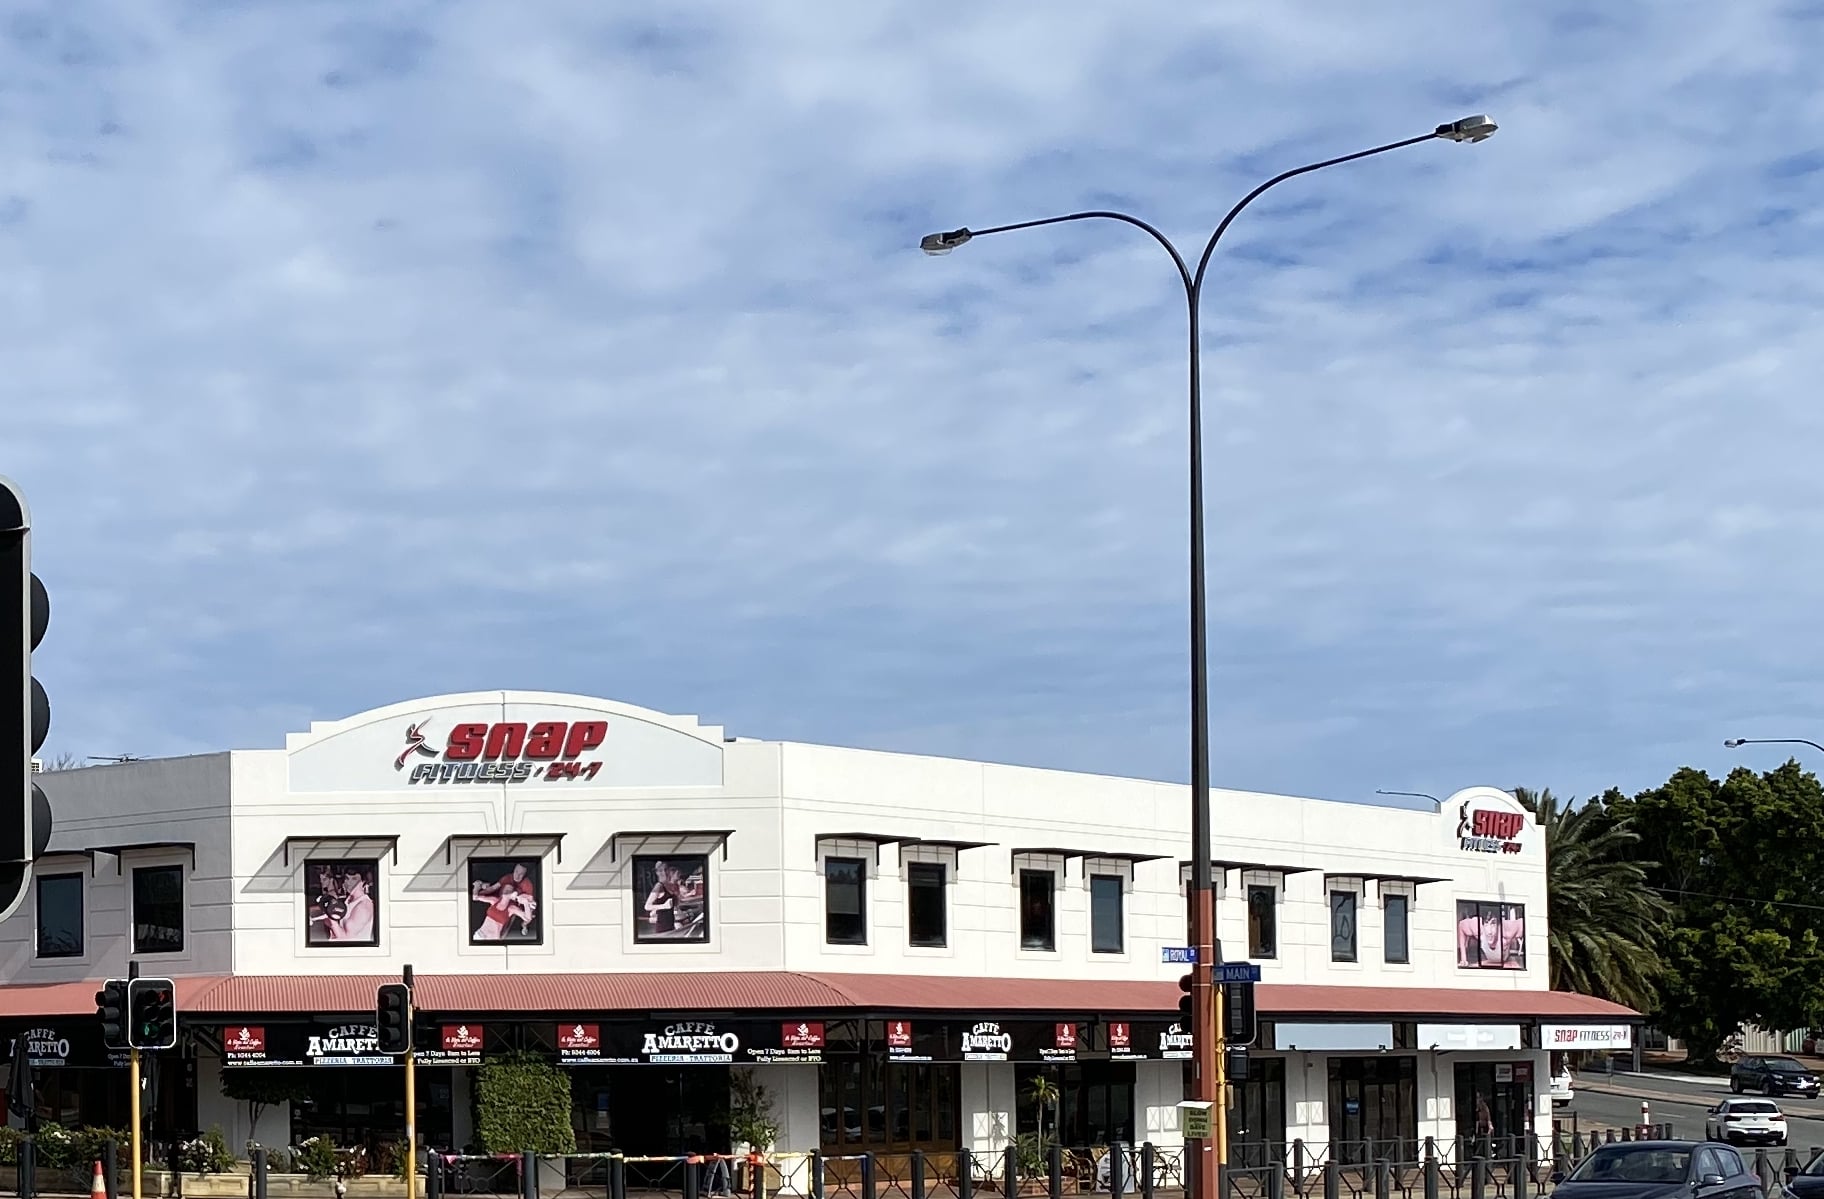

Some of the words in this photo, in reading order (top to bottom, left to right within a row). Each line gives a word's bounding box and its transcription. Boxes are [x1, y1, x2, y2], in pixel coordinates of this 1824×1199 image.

[1169, 949, 1190, 961] ROYAL
[1226, 967, 1250, 980] MAIN
[641, 1032, 739, 1053] AMARETTO
[961, 1032, 1012, 1052] AMARETTO
[430, 1050, 445, 1058] Days
